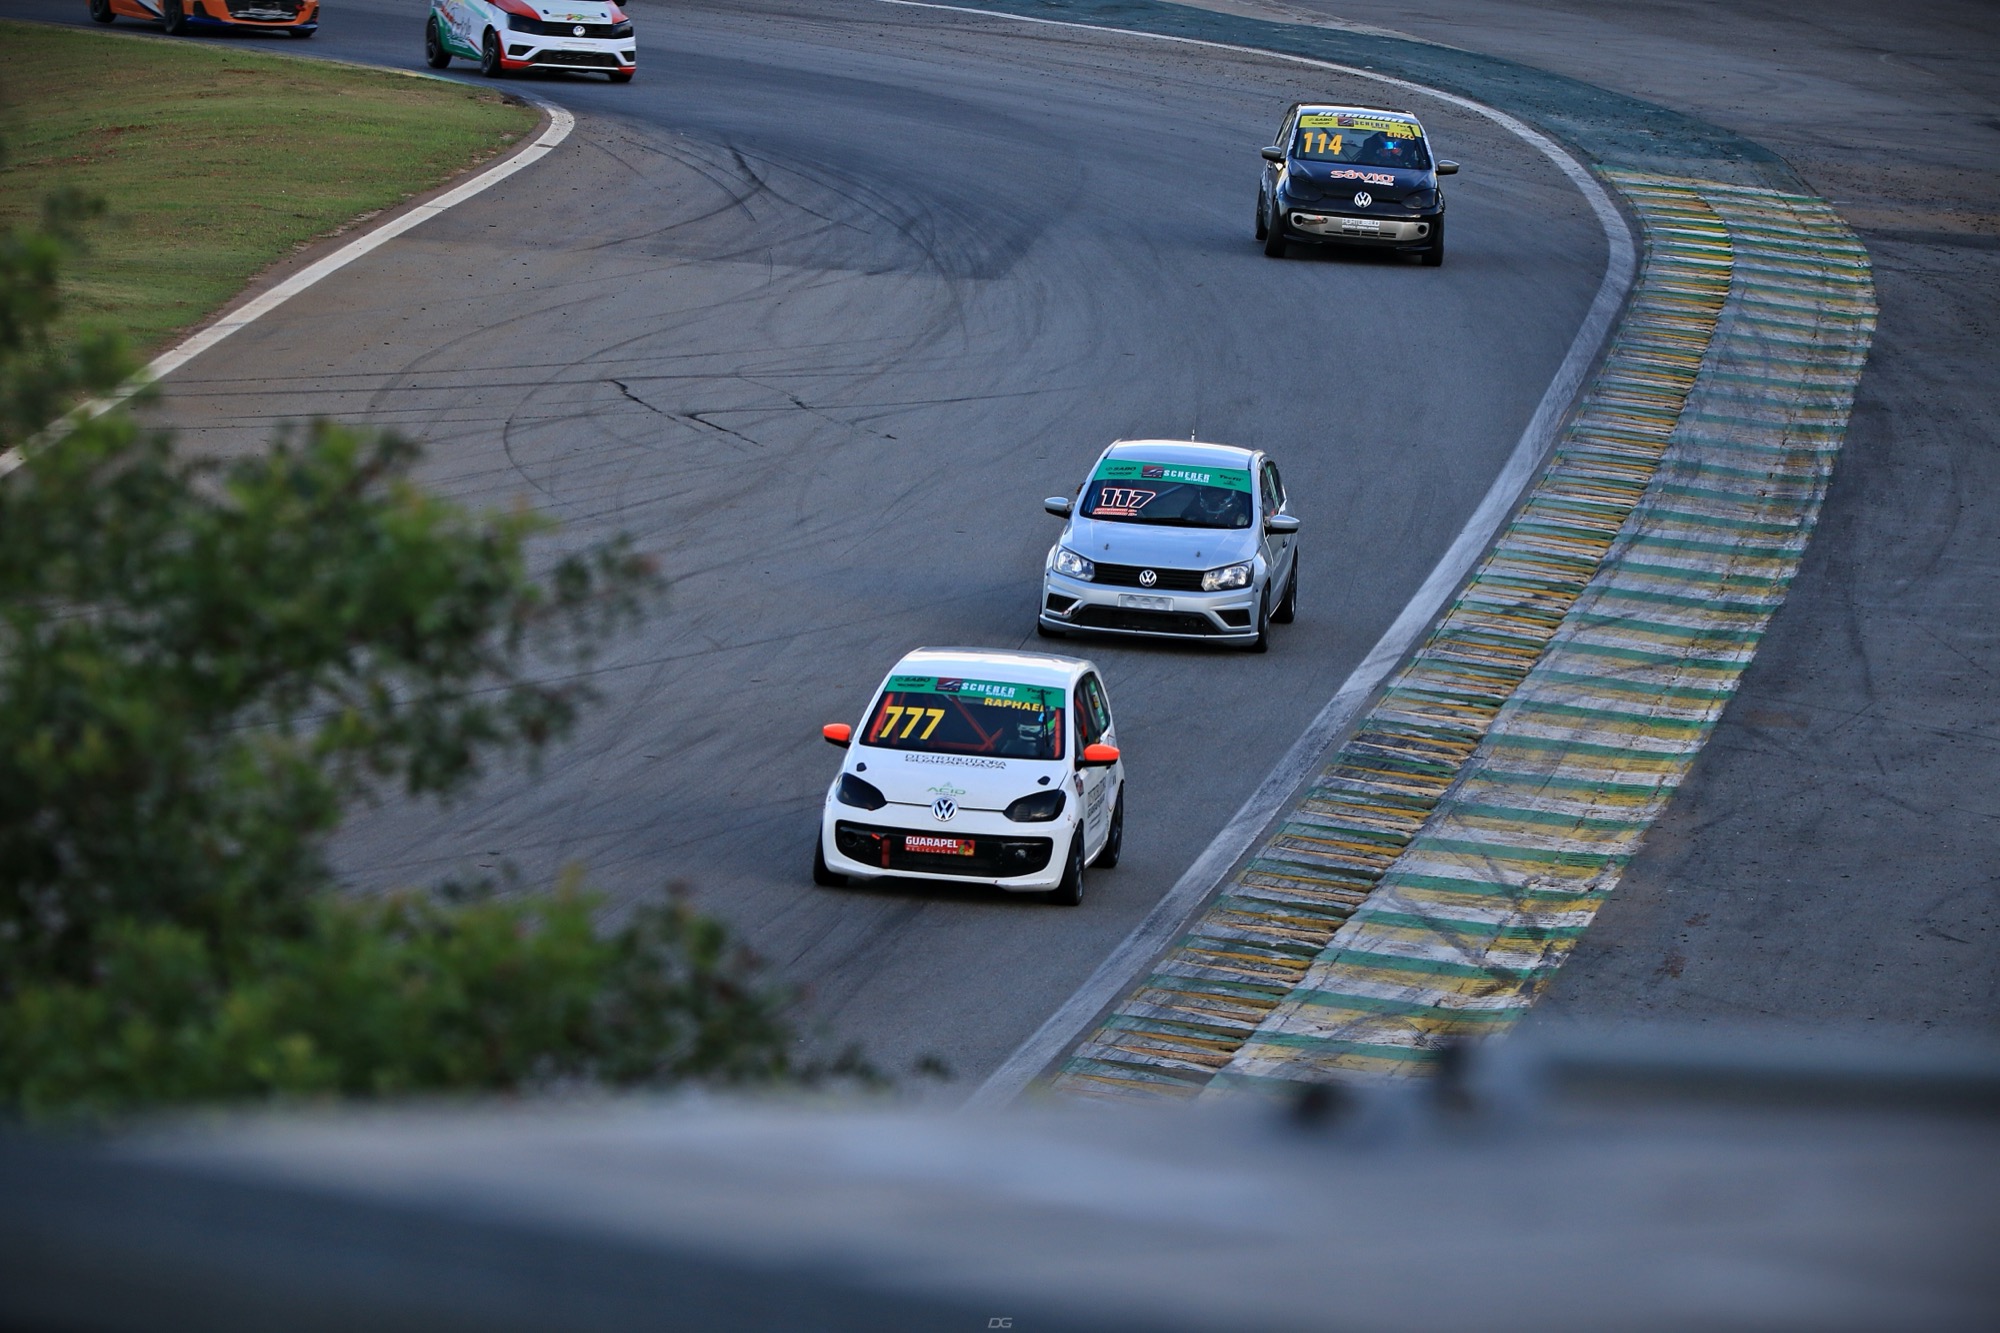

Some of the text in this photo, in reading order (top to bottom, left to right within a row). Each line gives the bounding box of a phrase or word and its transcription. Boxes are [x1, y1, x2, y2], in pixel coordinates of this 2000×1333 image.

[1304, 131, 1343, 156] 114
[1386, 131, 1416, 141] ENZO
[1163, 469, 1210, 482] SCHERER
[1101, 487, 1157, 509] 117
[1139, 569, 1157, 587] VW
[961, 682, 1016, 696] SCHERER
[879, 705, 946, 740] 777
[932, 797, 959, 822] VW
[905, 836, 959, 848] GUARAPEL
[905, 847, 958, 855] RECICLAGEM
